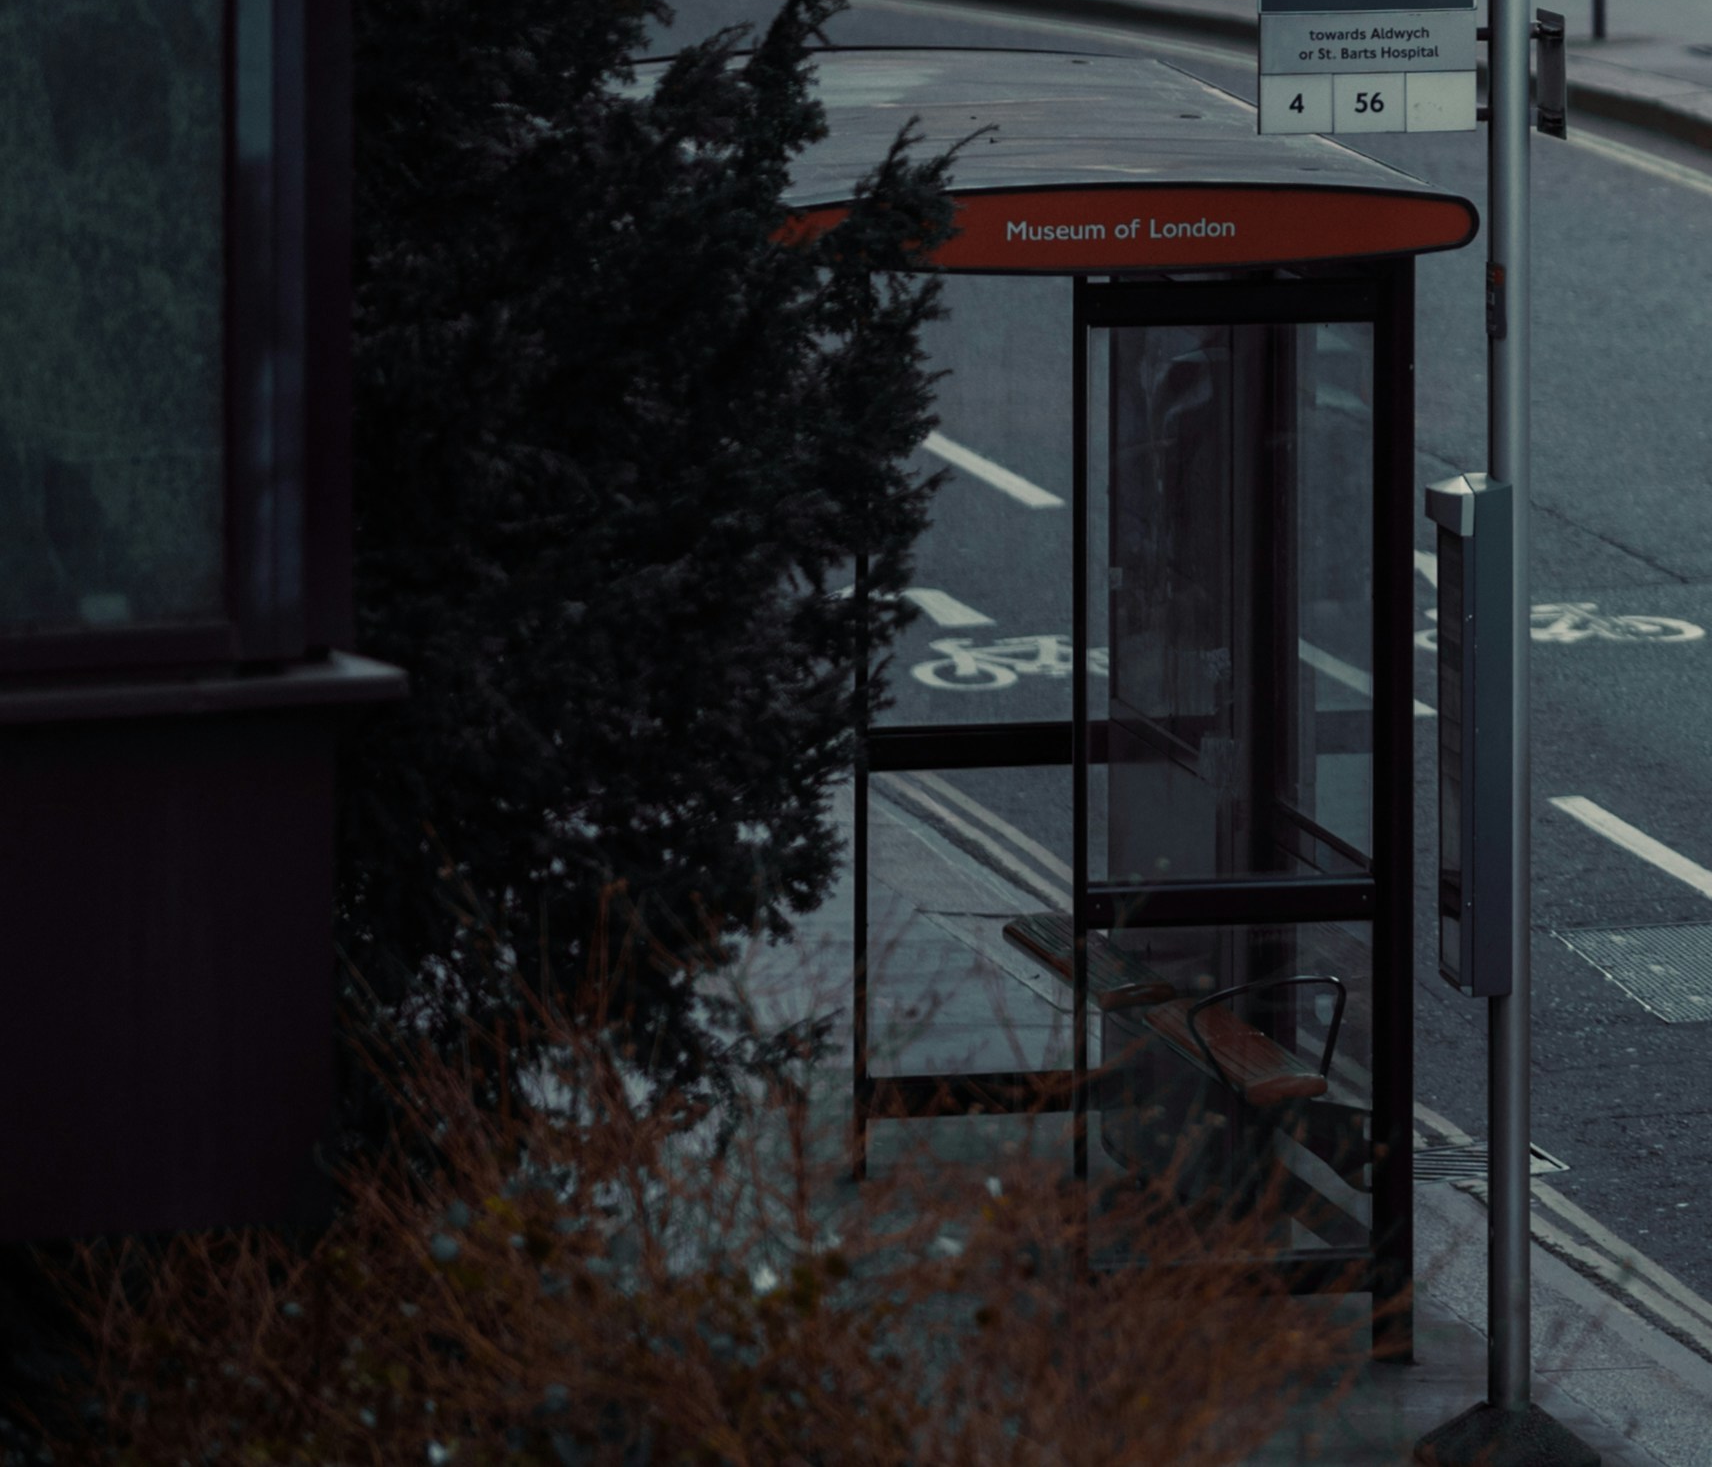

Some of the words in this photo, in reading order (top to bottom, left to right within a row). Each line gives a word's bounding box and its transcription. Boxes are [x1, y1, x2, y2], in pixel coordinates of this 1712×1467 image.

[1309, 28, 1366, 41] towards
[1370, 26, 1430, 42] Aldwych
[1298, 50, 1314, 60] or
[1317, 47, 1337, 60] St.
[1341, 46, 1377, 60] Barts
[1380, 45, 1439, 61] Hospital
[1289, 93, 1305, 114] 4
[1354, 92, 1385, 114] 56
[1006, 220, 1106, 242] Museum
[1114, 219, 1140, 240] of
[1149, 218, 1236, 239] London
